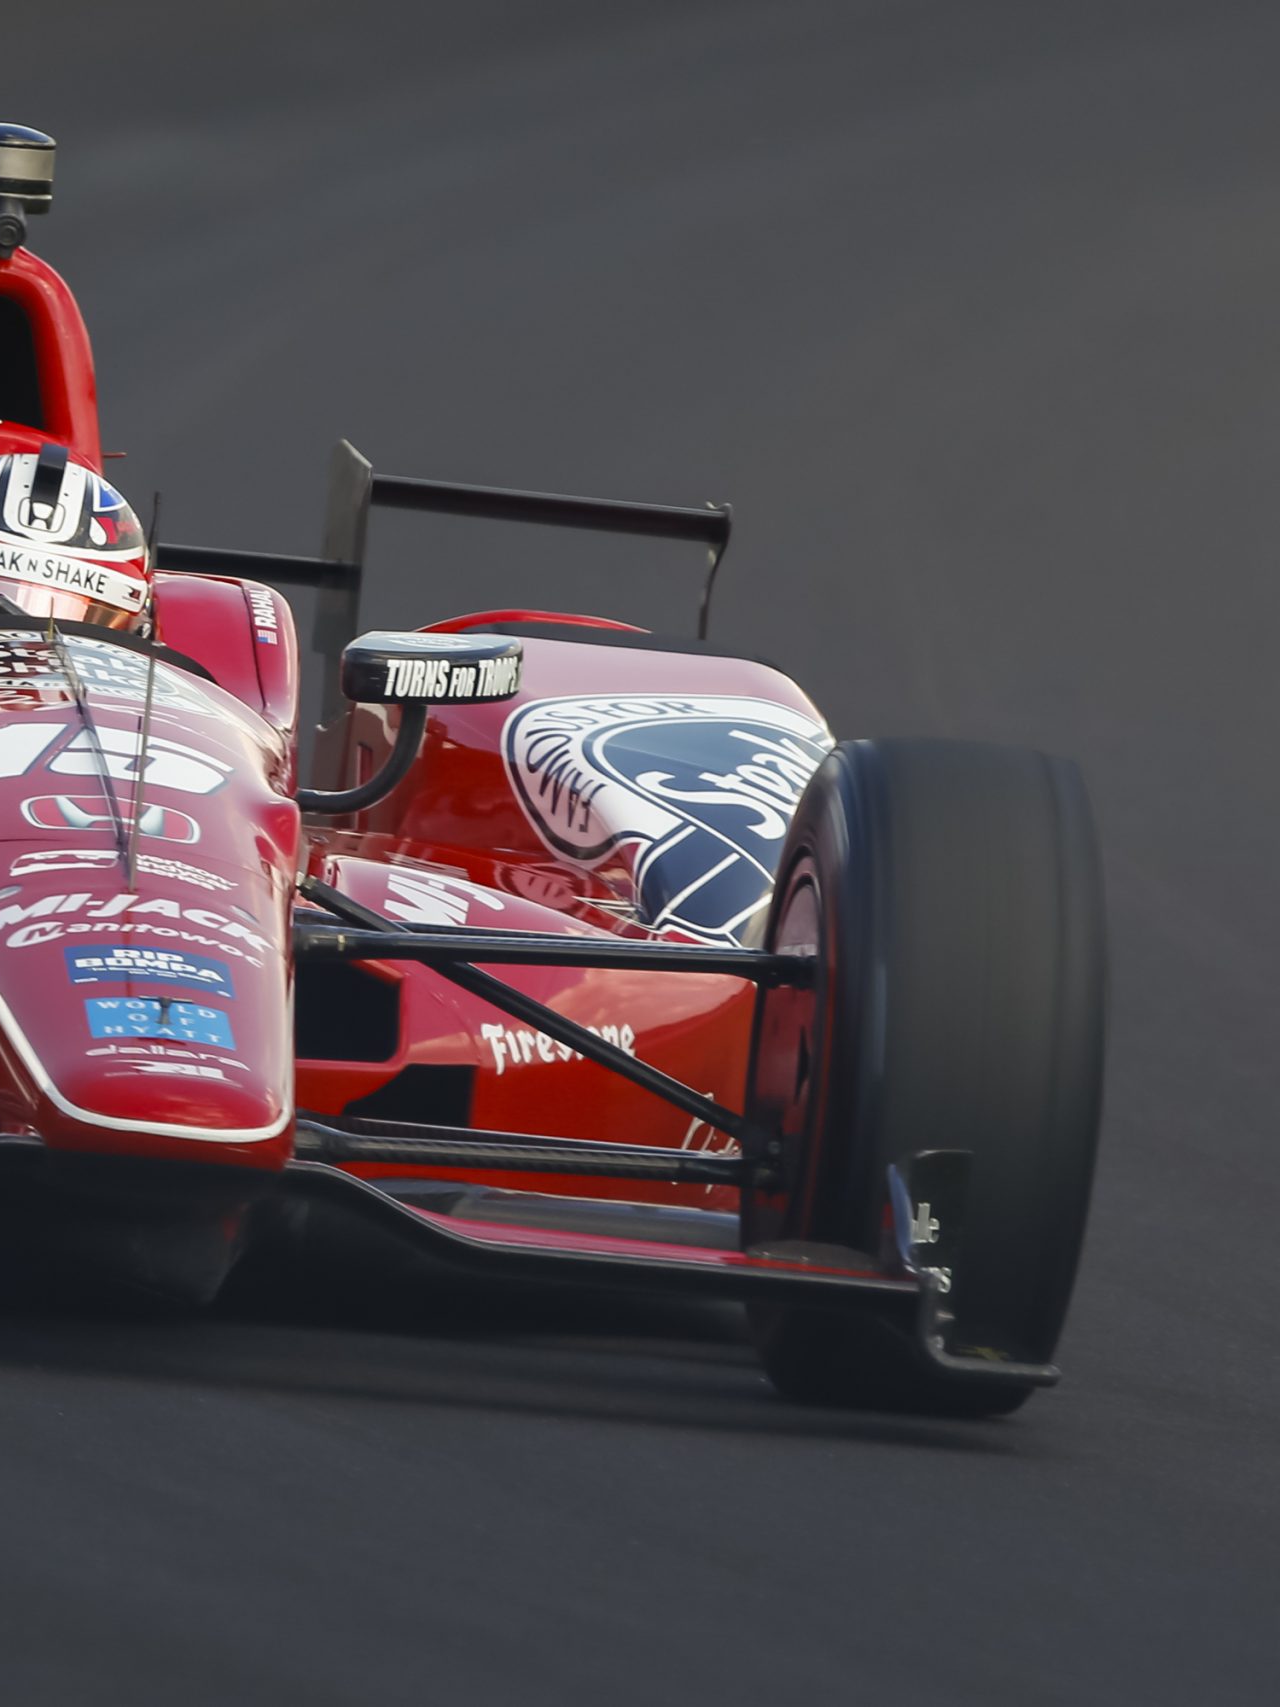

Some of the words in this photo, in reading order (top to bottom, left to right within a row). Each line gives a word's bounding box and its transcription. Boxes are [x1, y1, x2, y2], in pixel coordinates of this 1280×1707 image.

[27, 558, 38, 573] N
[41, 559, 110, 595] SHAKE
[384, 659, 451, 698] TURNS
[448, 666, 477, 698] FOR
[524, 710, 609, 833] FAMOUS
[577, 701, 719, 719] FOR
[103, 1025, 222, 1044] HYATT
[127, 1013, 195, 1027] OF
[481, 1023, 635, 1076] Firesne
